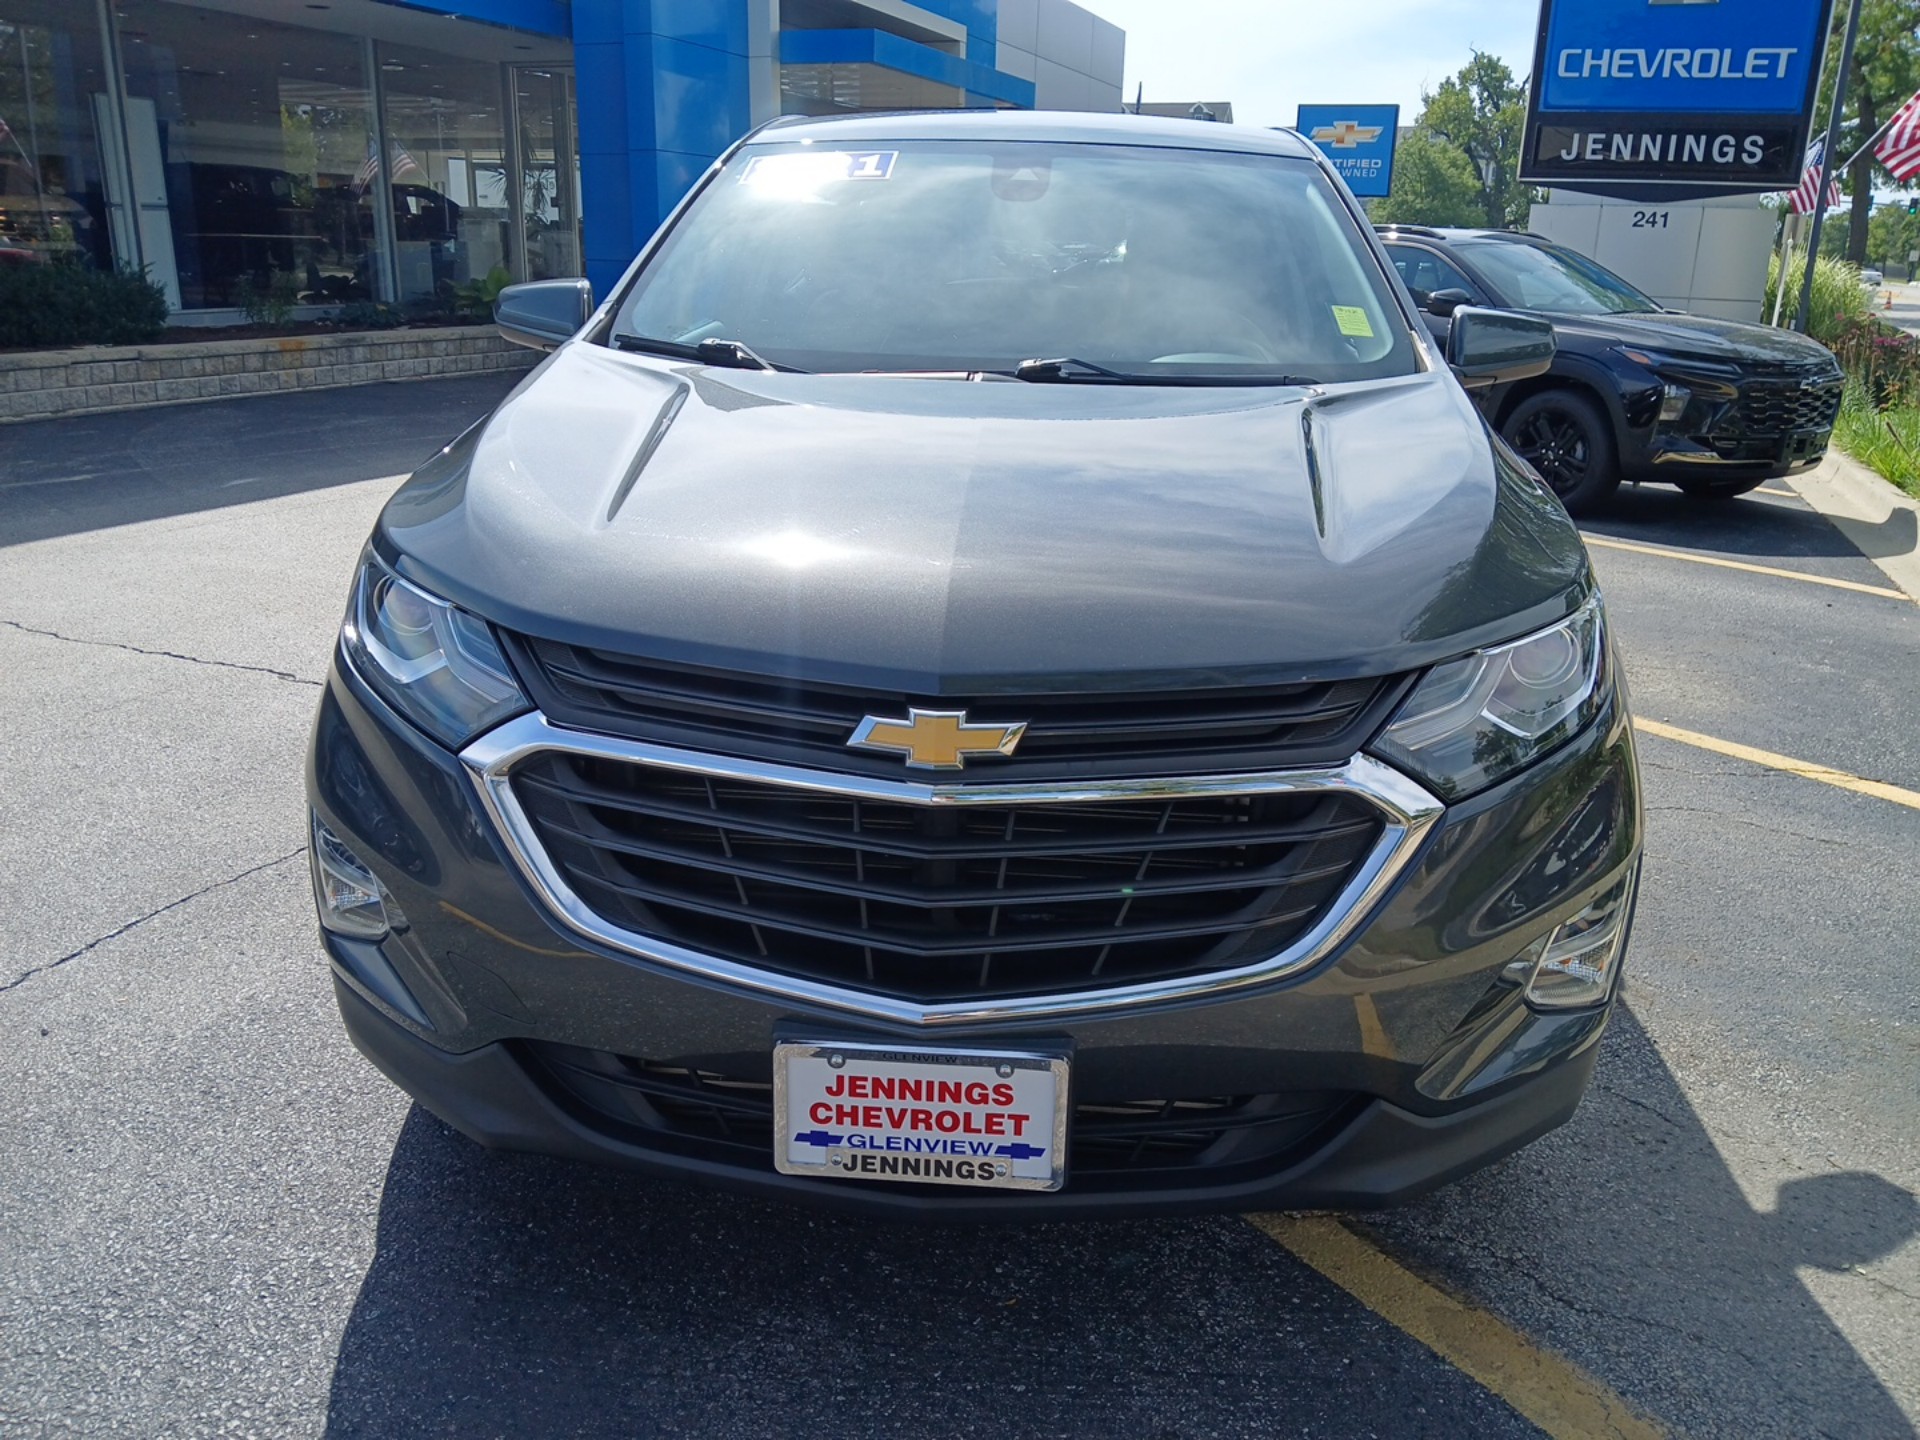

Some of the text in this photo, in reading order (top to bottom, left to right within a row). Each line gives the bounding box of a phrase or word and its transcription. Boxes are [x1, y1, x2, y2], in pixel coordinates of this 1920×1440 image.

[1557, 47, 1798, 79] CHEVROLET
[1560, 132, 1765, 165] JENNINGS
[1332, 158, 1382, 169] TIFIED
[1632, 210, 1669, 229] 241
[882, 1051, 958, 1064] GLENVIEW
[825, 1075, 1014, 1106] JENNINGS
[809, 1102, 1030, 1136] CHEVROLET
[846, 1133, 994, 1156] GLENVIEW
[842, 1154, 996, 1181] JENNINGS
